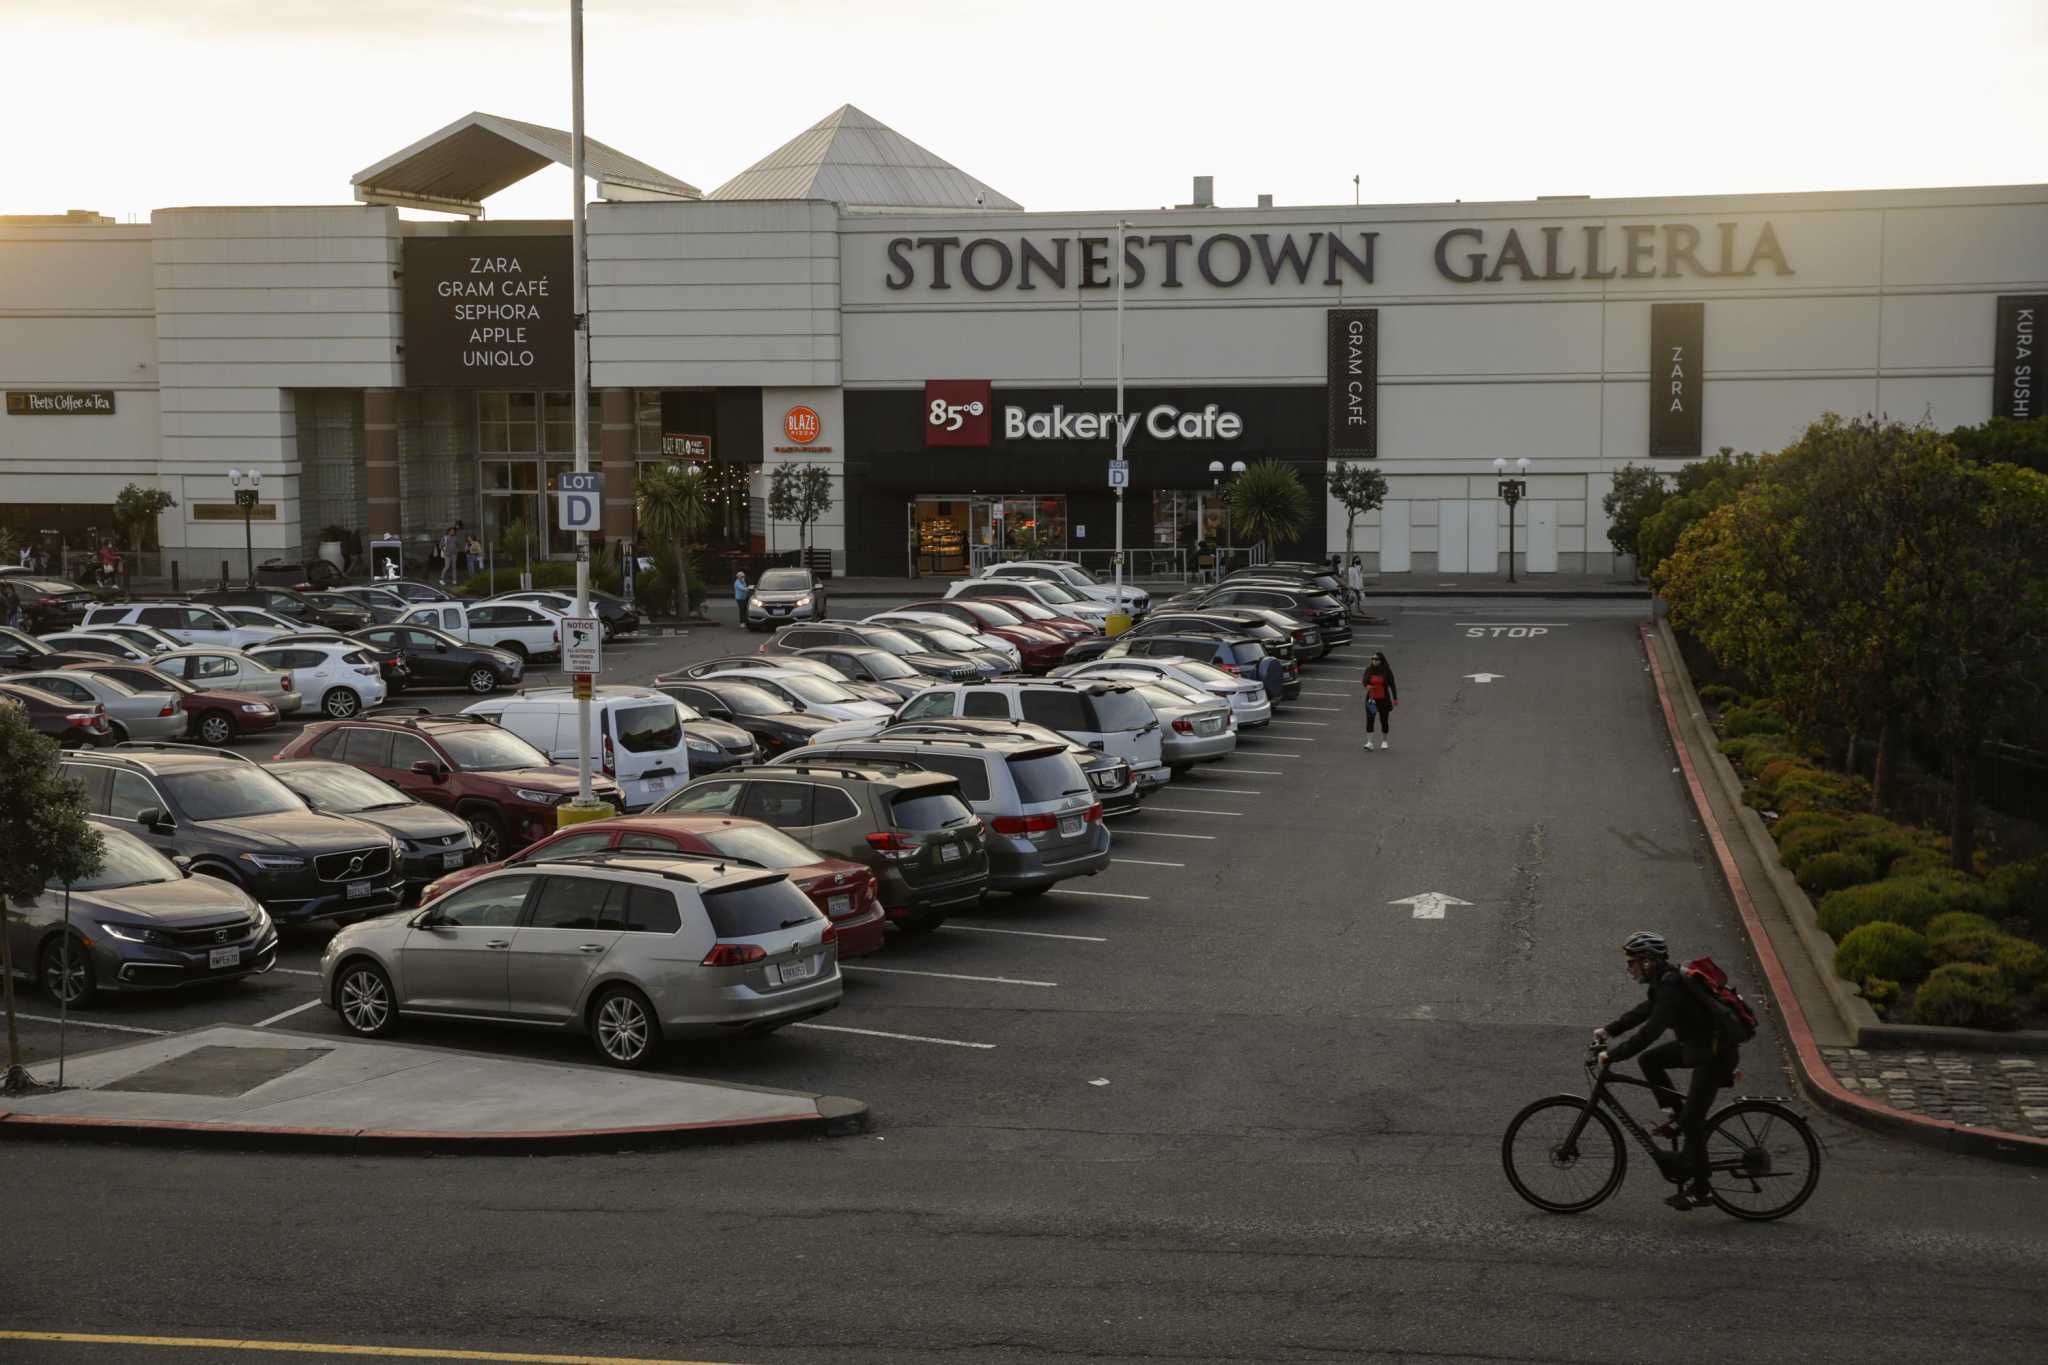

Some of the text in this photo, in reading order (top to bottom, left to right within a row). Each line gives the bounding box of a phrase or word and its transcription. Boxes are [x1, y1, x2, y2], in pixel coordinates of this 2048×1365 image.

[885, 220, 1796, 291] STONESTOWN GALLERIA
[470, 257, 522, 273] ZARA
[438, 276, 549, 297] GRAM CAFÉ
[455, 304, 541, 321] SEPHORA
[469, 327, 528, 343] APPLE
[463, 350, 534, 367] UNIQLO
[2013, 309, 2034, 417] KURA SUSHI
[1348, 320, 1367, 426] GRAM CAFÉ
[1670, 346, 1684, 412] ZARA
[55, 394, 84, 411] Coffee
[92, 394, 110, 409] Tea
[789, 414, 816, 430] BLAZE
[1004, 403, 1243, 447] Bakery Cafe
[563, 476, 595, 489] LOT
[1112, 470, 1125, 485] D
[567, 495, 592, 526] D
[567, 622, 595, 630] NOTICE
[1465, 627, 1549, 638] STOP
